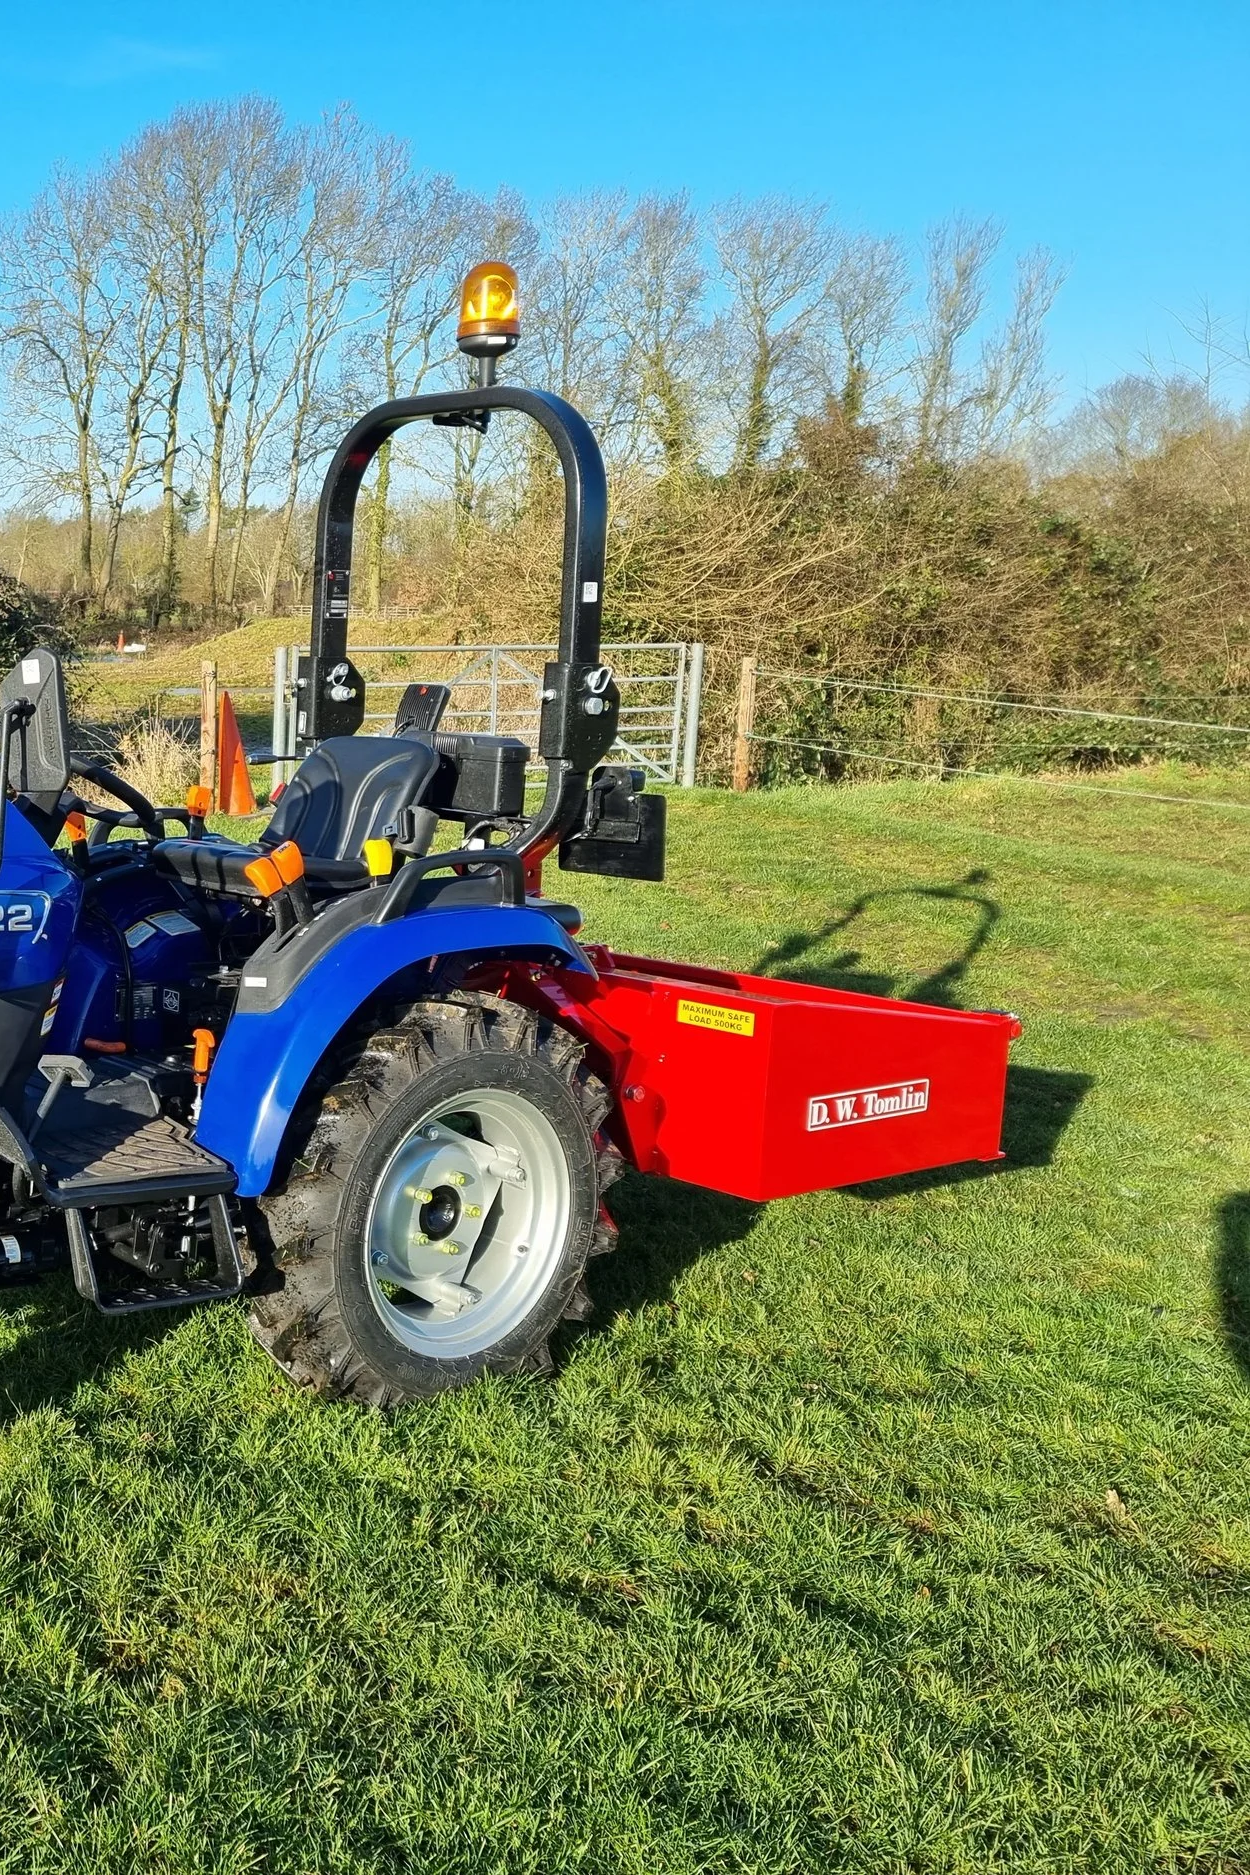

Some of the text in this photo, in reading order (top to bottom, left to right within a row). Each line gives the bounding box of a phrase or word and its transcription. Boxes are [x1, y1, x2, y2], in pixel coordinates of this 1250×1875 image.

[682, 1003, 751, 1024] MAXIMUM SAFE
[688, 1014, 743, 1031] LOAD 500KG
[810, 1086, 926, 1127] D. W. Tomlin
